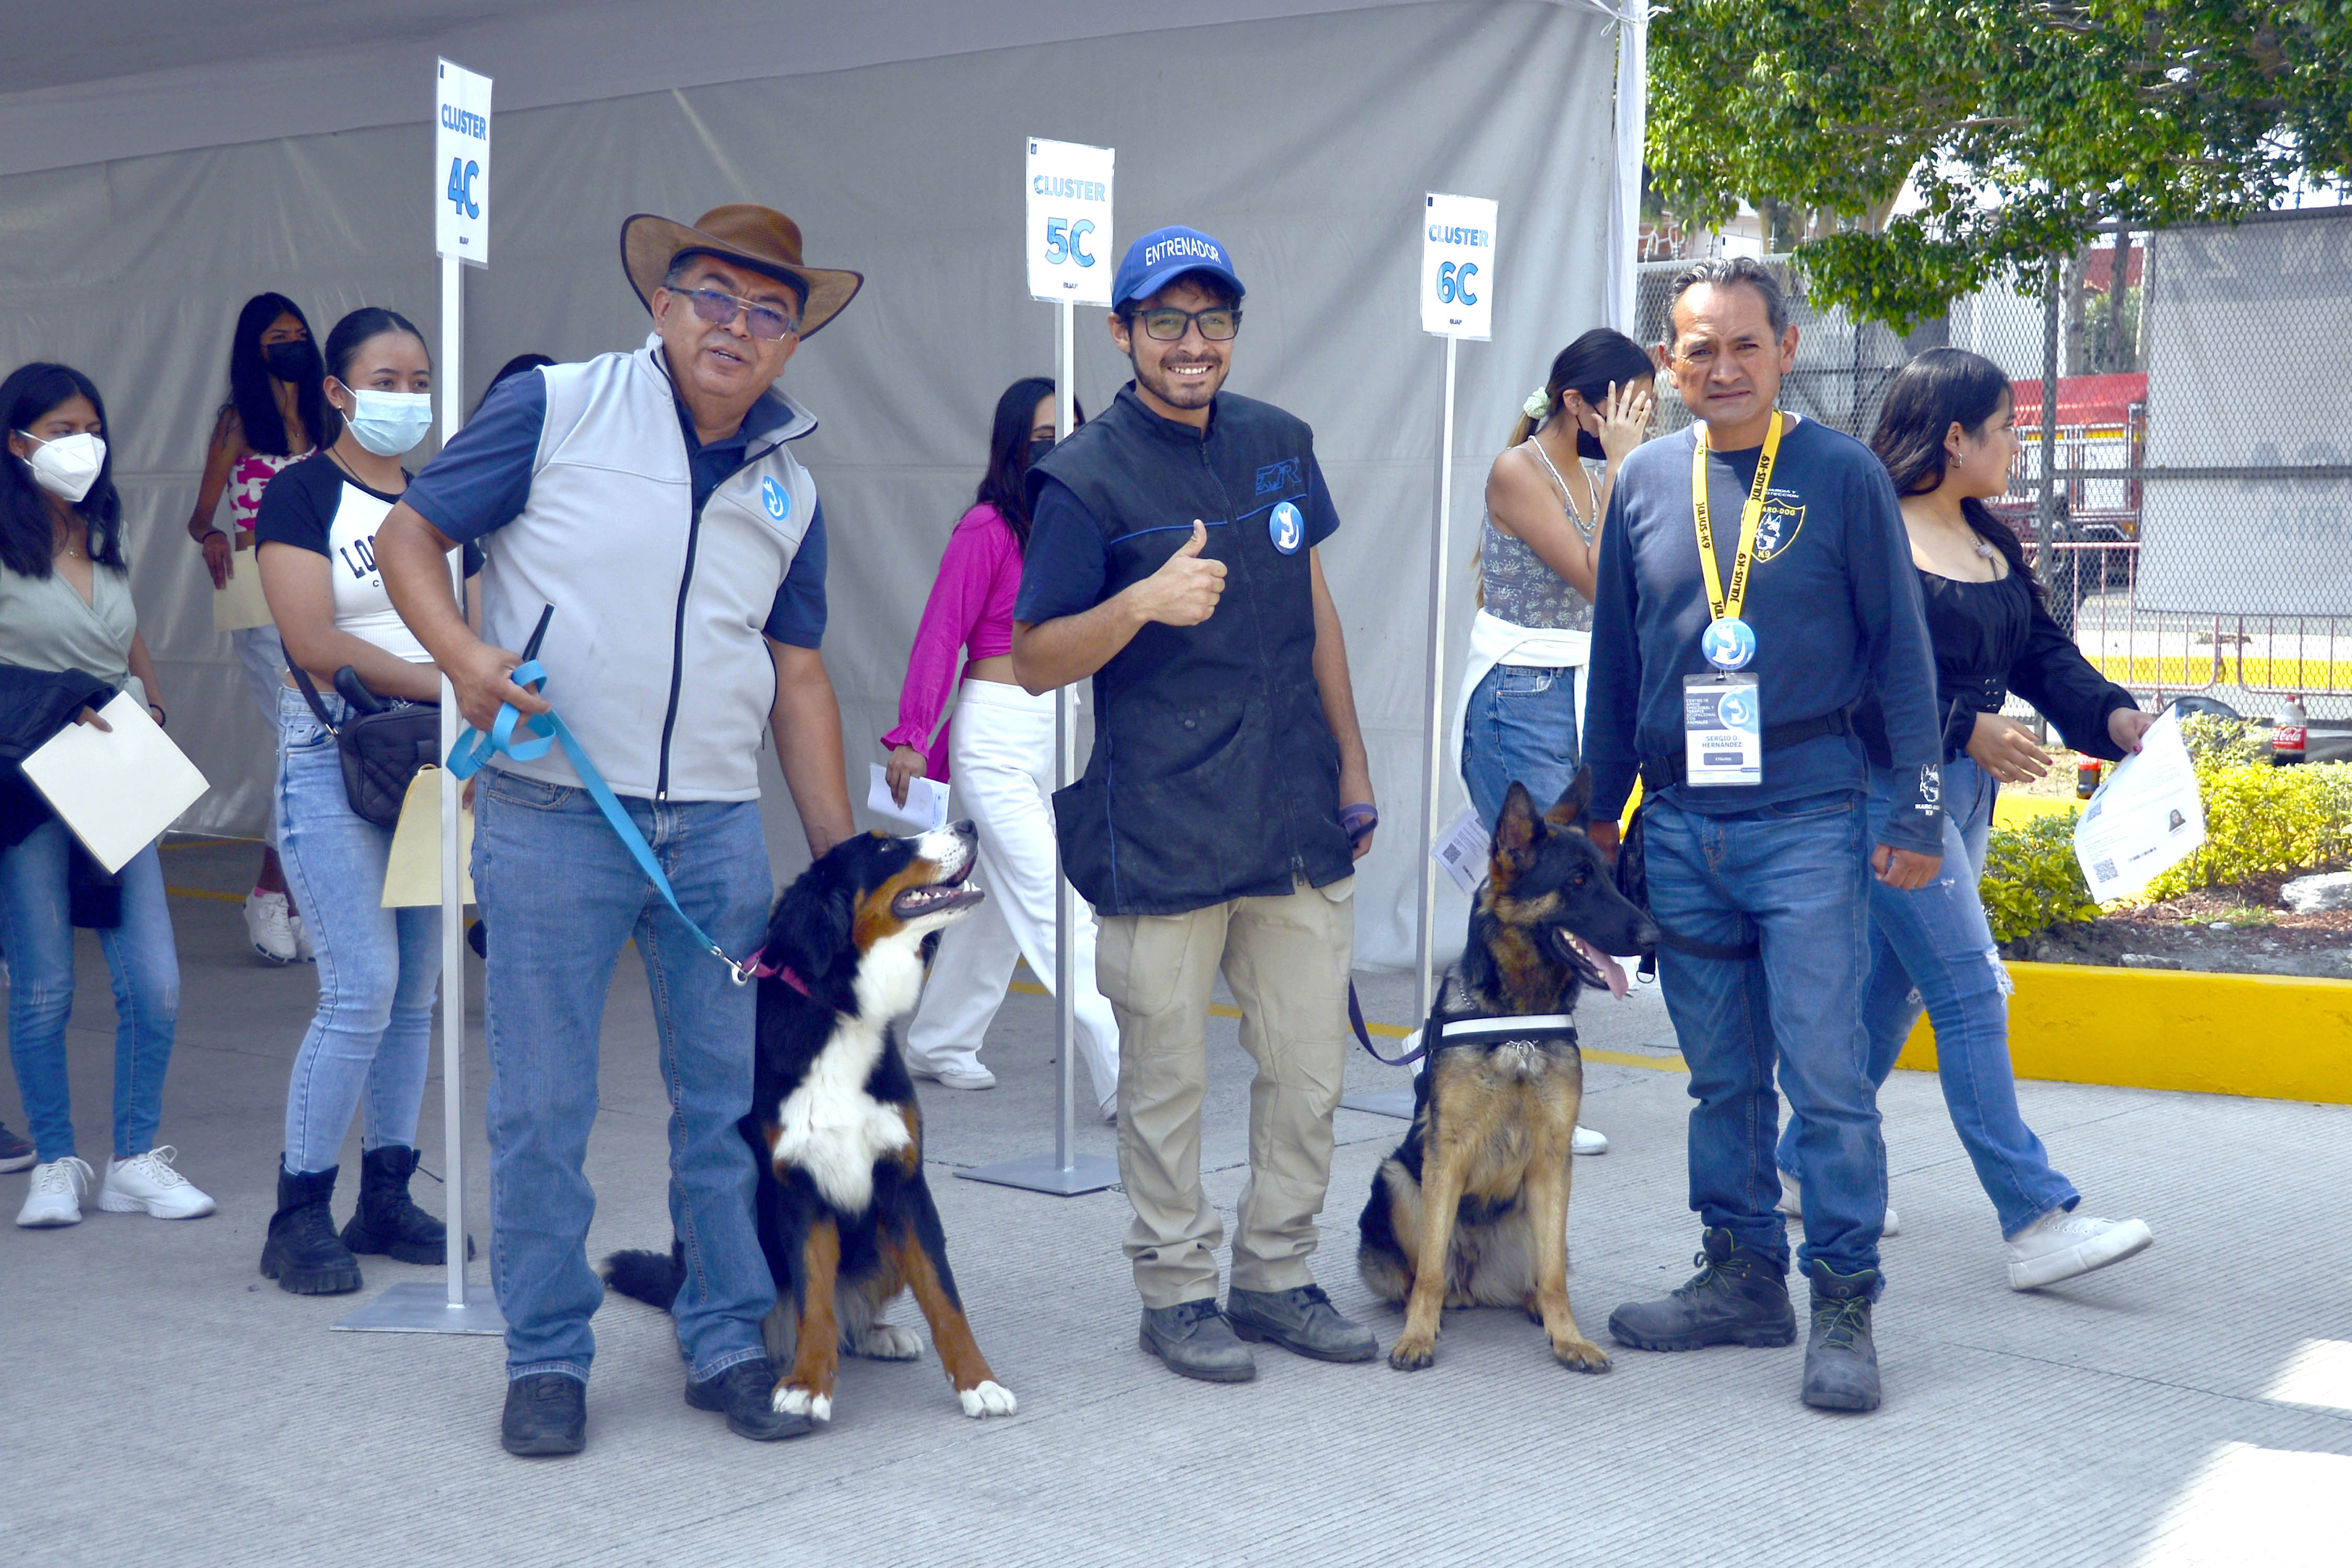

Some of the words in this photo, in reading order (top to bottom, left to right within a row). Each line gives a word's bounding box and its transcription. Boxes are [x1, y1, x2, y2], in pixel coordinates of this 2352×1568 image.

[441, 103, 487, 141] CLUSTER
[447, 157, 480, 220] 4C
[1033, 175, 1105, 202] CLUSTER
[1045, 217, 1096, 268] 5C
[1145, 237, 1221, 266] ENTRENADOR
[1428, 224, 1489, 247] CLUSTER
[1436, 261, 1479, 306] 6C
[1751, 455, 1770, 502] JULIUS-K9
[1696, 502, 1711, 549] JULIUS-K9
[1762, 506, 1795, 516] ARO-DOG
[1730, 551, 1746, 603] JULIUS-K9
